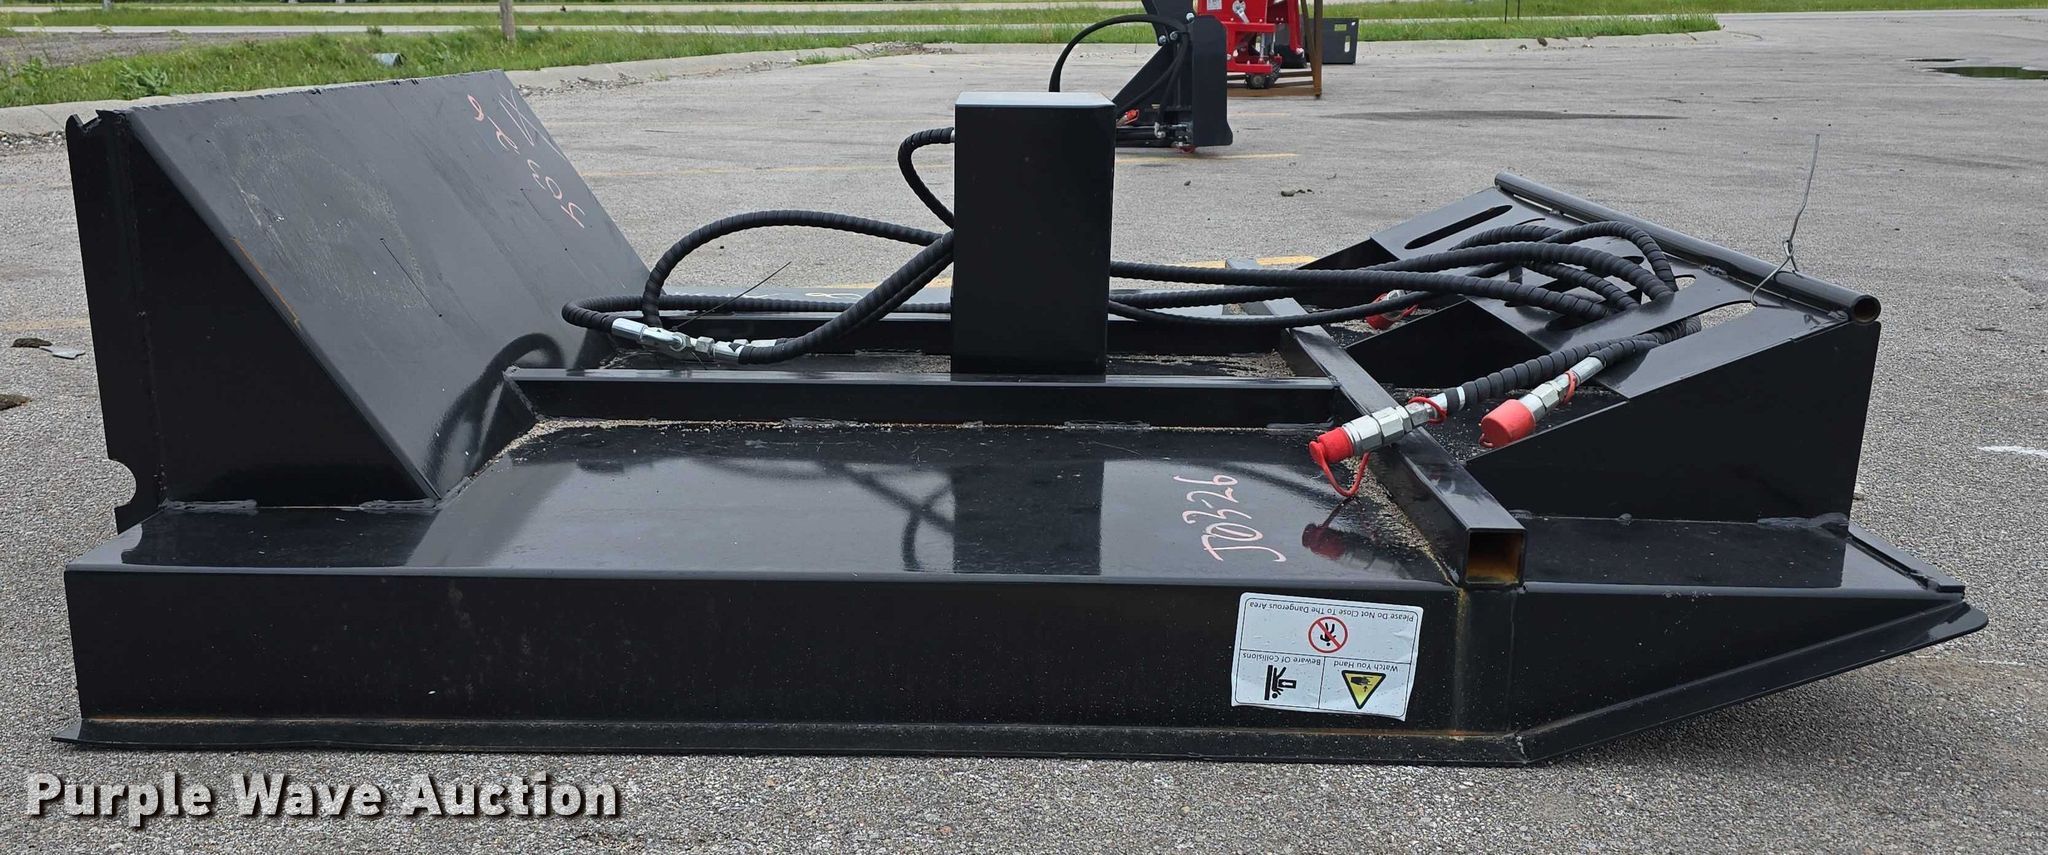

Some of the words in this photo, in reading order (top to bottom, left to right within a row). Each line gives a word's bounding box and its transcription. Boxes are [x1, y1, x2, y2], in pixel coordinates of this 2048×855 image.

[1270, 603, 1309, 613] Dangerous
[1339, 609, 1358, 617] Close
[1391, 613, 1414, 621] Please
[1243, 653, 1280, 661] Collisions
[1293, 657, 1321, 665] Beware
[1334, 660, 1354, 668] Hand
[1374, 664, 1398, 672] Watch
